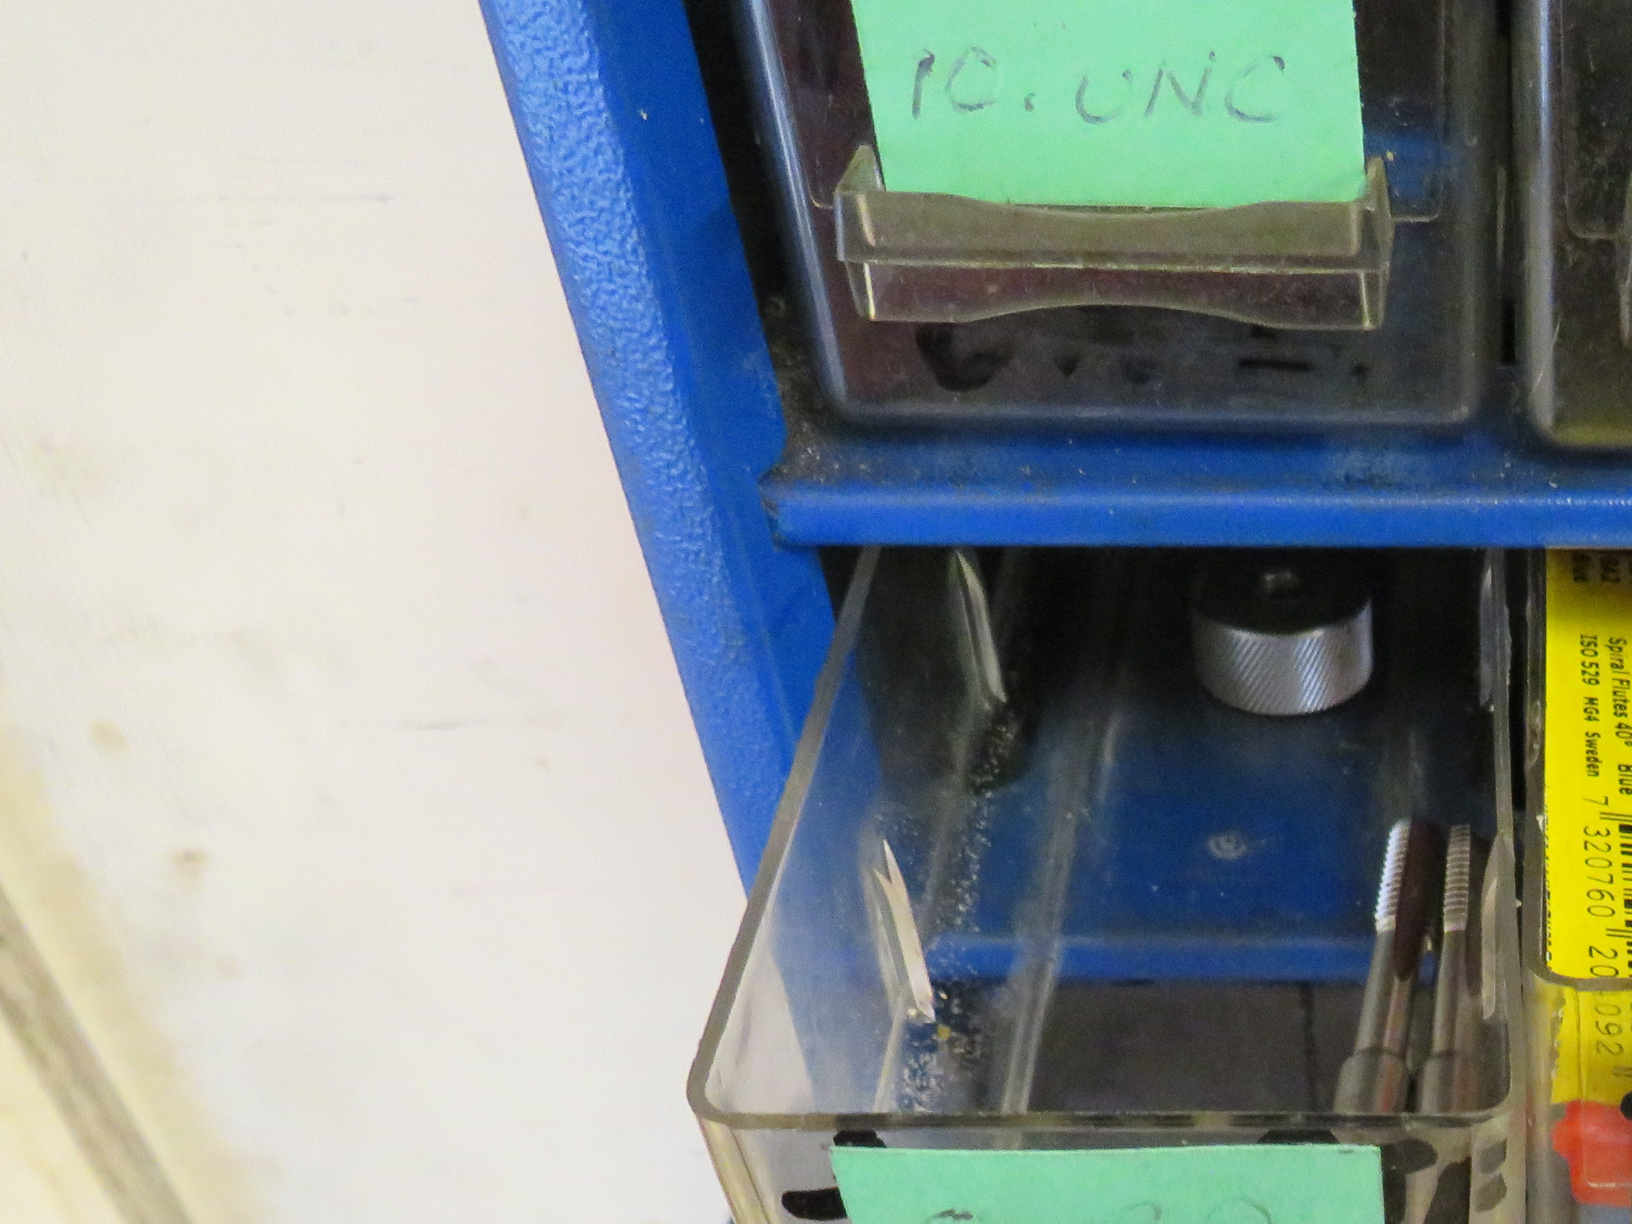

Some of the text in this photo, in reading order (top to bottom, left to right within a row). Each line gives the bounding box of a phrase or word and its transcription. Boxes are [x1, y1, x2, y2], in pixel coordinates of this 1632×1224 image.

[1604, 637, 1630, 675] Spiral
[1611, 677, 1631, 718] Flutes
[1579, 634, 1603, 777] ISO 529 MG4 Sweden
[1583, 825, 1615, 918] 320760
[1588, 945, 1624, 1055] 20092
